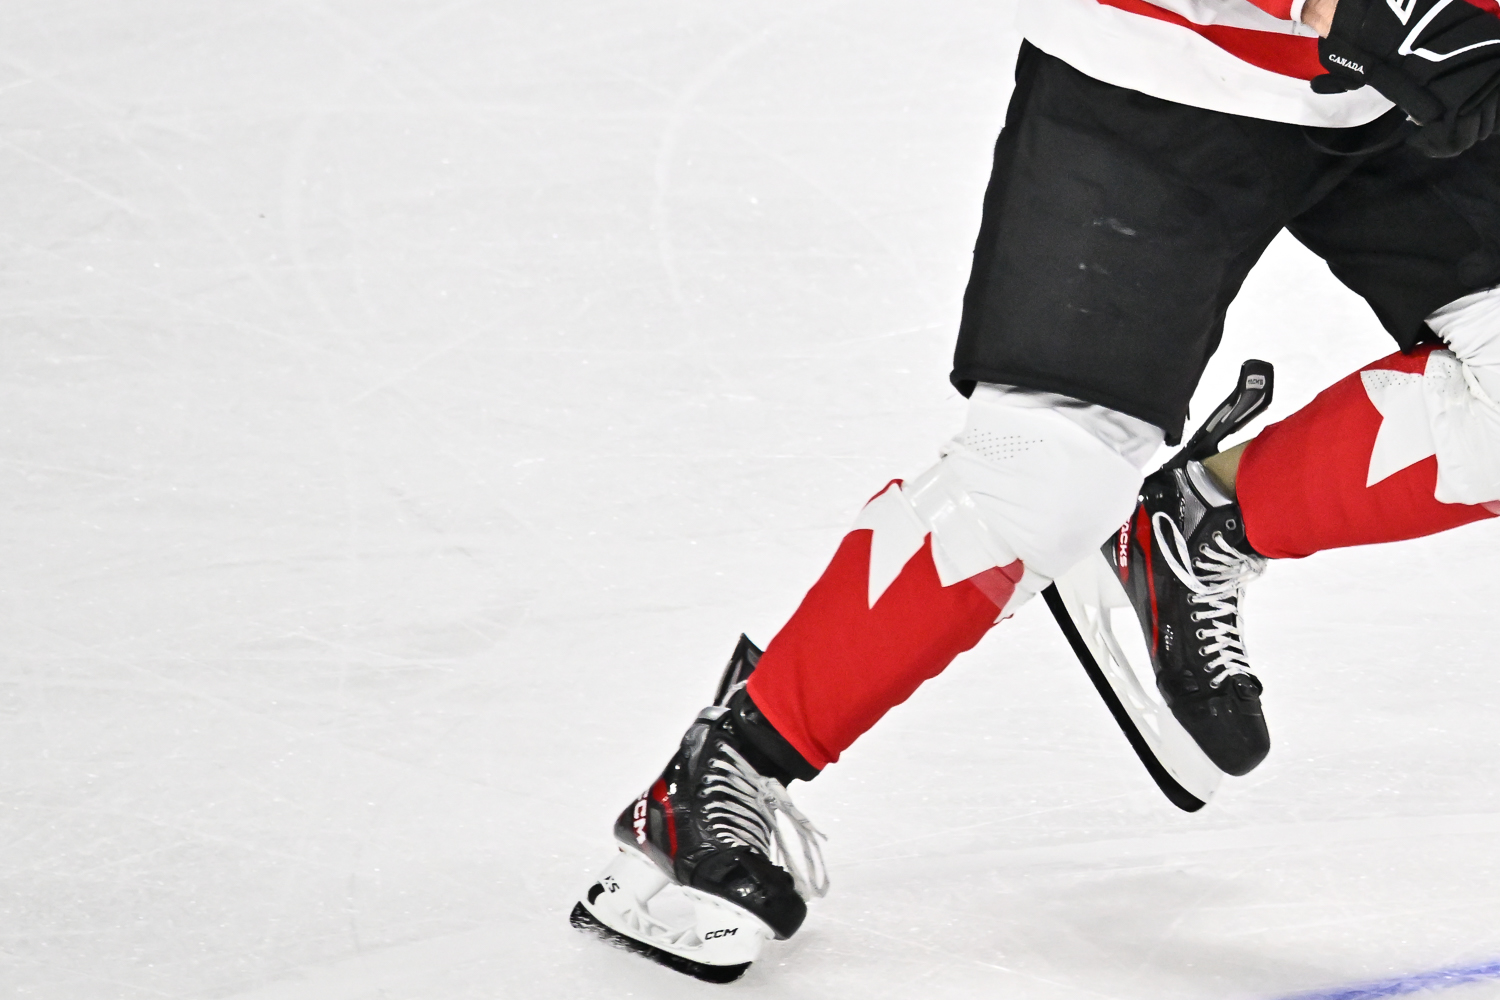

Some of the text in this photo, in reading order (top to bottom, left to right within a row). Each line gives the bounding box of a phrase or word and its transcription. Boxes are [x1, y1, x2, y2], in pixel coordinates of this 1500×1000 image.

[1328, 53, 1364, 75] CANADA
[1120, 517, 1130, 568] ACKS
[704, 927, 739, 941] CCM
